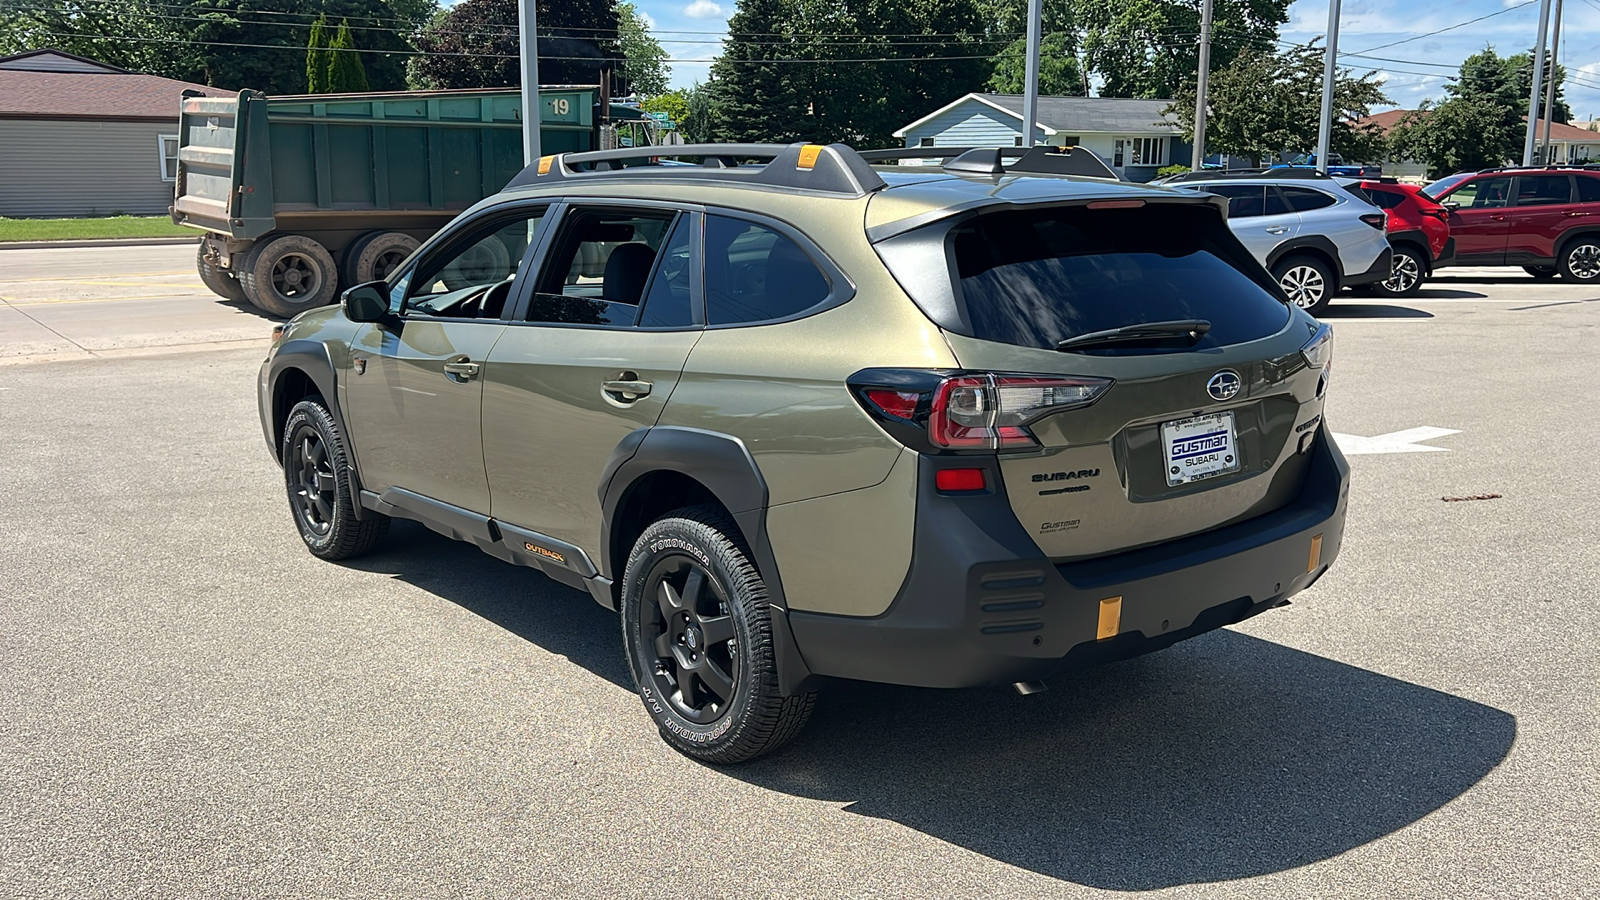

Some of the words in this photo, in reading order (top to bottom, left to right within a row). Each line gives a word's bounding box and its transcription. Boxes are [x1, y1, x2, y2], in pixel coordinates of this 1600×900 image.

[552, 98, 569, 115] 19
[1185, 453, 1219, 466] SUBARU
[1031, 468, 1100, 482] SUBARU
[525, 542, 564, 562] OUTBACK
[650, 538, 709, 566] YOKOHAMA
[642, 686, 663, 714] A/T
[664, 716, 732, 743] GEOLANDAR
